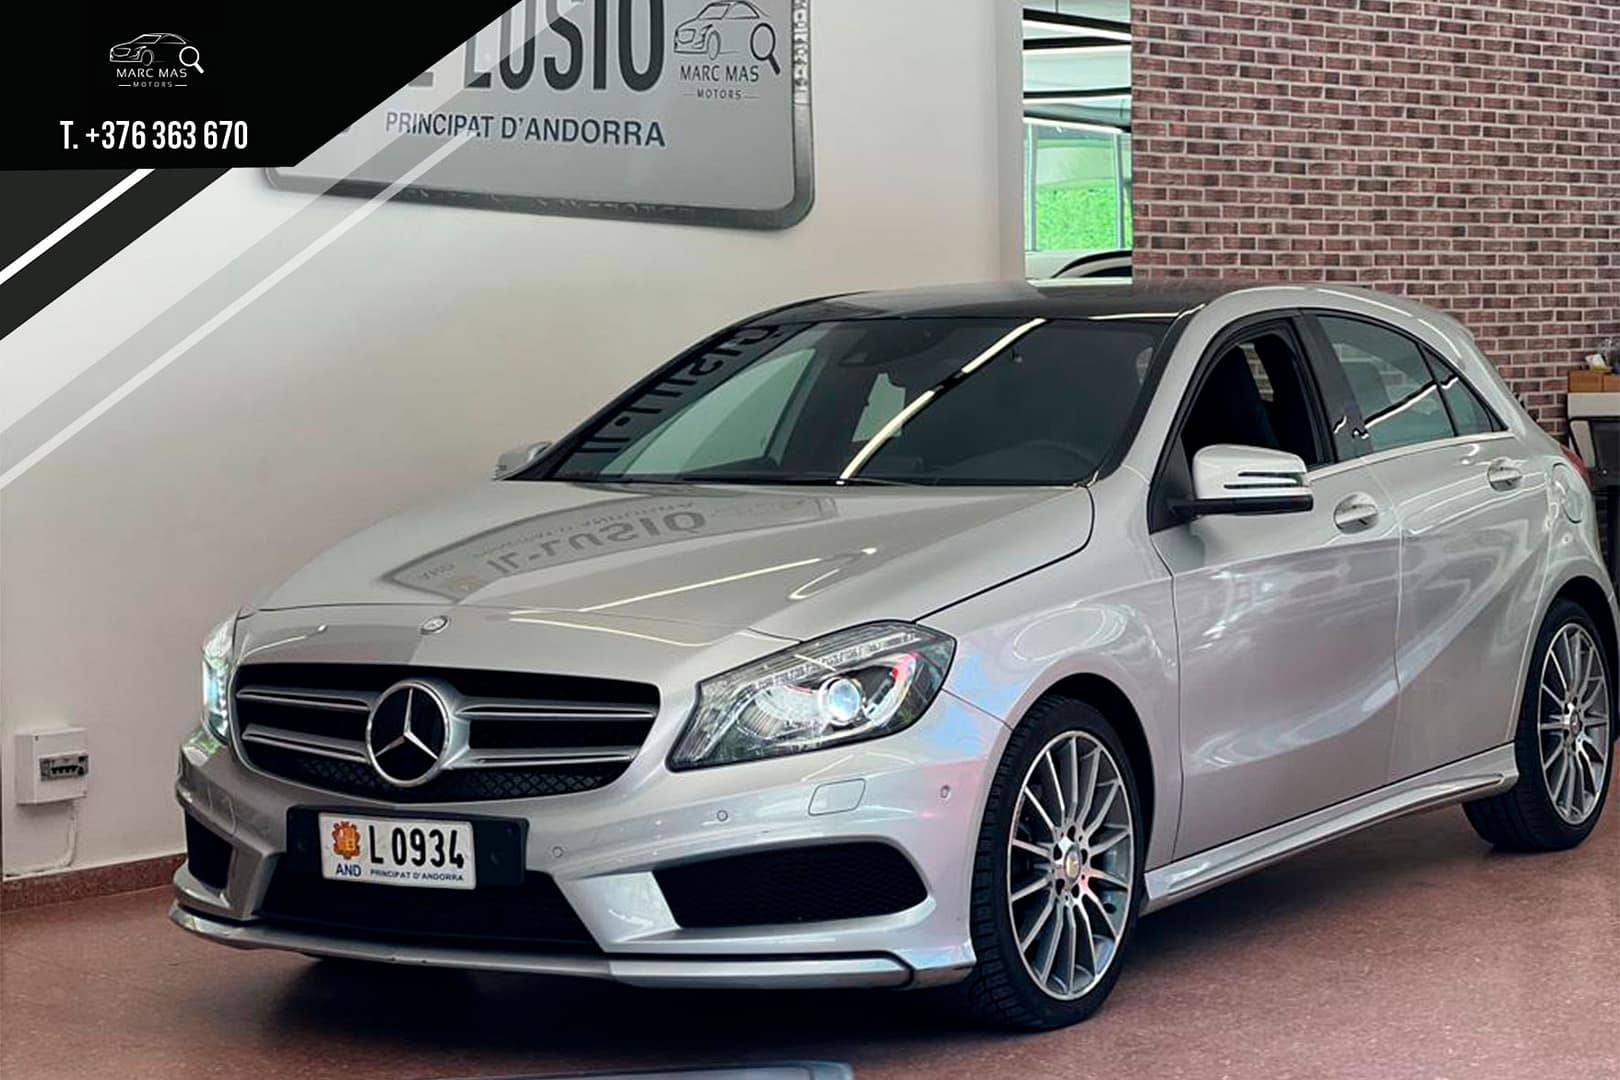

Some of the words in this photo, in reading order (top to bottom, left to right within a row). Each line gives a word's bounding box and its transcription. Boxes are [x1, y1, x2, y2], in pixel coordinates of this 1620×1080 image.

[679, 64, 720, 82] MARC
[725, 65, 760, 83] MAS
[696, 88, 742, 100] MOTORS
[384, 111, 495, 138] PRINCIPAT
[501, 116, 667, 148] D'ANDORRA
[369, 825, 384, 864] L
[392, 827, 464, 869] 0934
[335, 863, 362, 877] AND
[370, 869, 410, 880] PRINCIPAT
